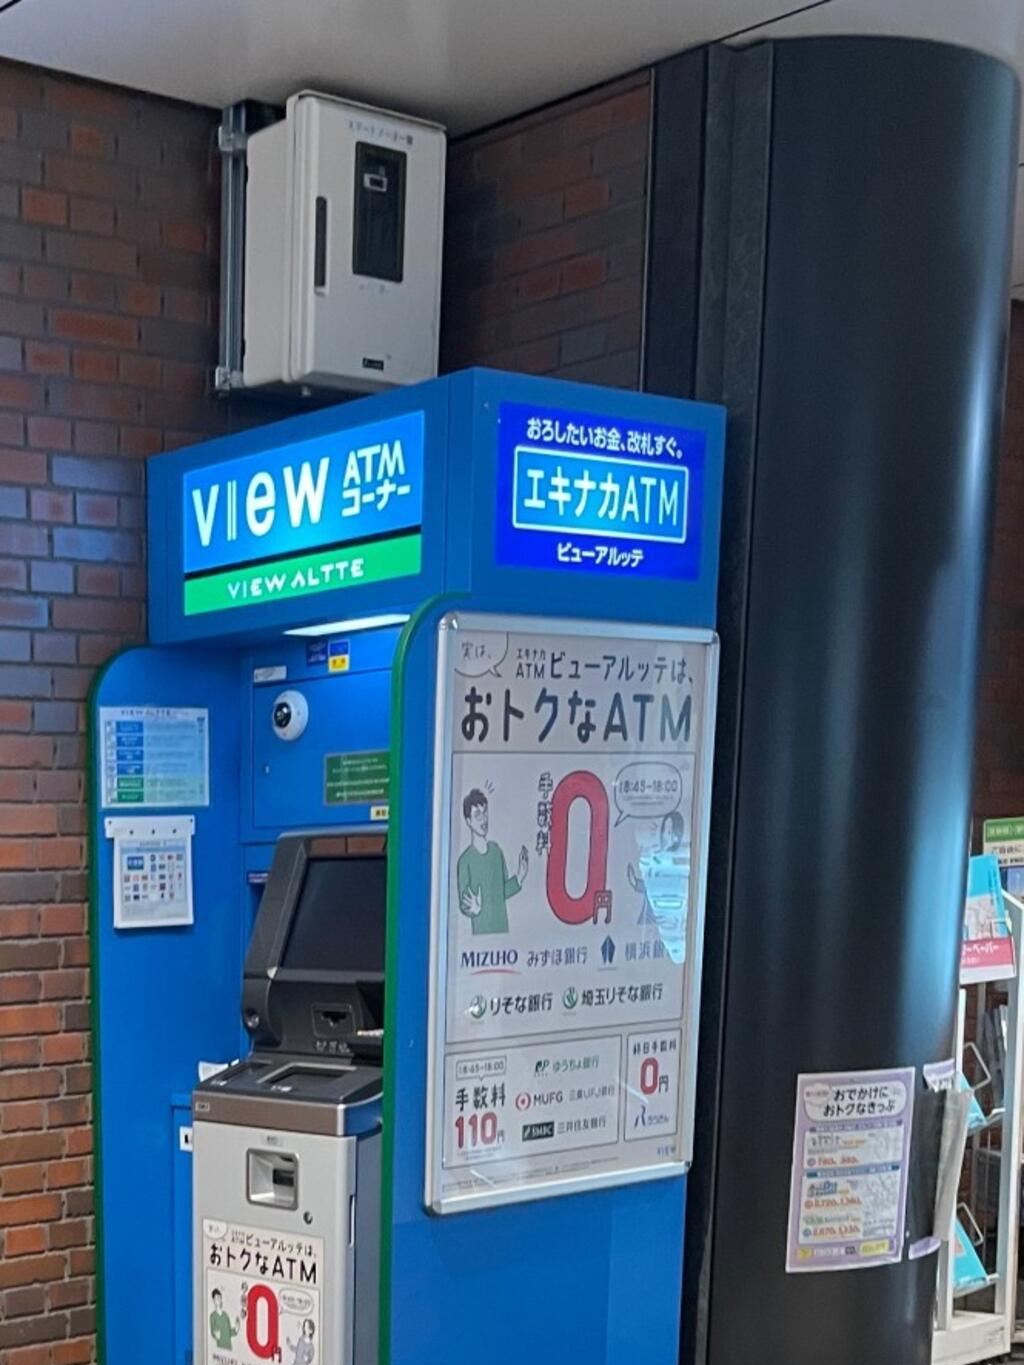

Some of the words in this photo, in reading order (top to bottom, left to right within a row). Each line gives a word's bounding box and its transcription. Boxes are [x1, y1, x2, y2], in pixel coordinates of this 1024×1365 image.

[527, 417, 683, 460] おろしたいお金、改札すぐ。
[343, 440, 406, 488] ATM
[341, 479, 410, 517] コーナー
[524, 466, 679, 526] エキナカATM
[557, 542, 644, 567] ビューアルッテ
[228, 573, 288, 600] VIEW
[291, 557, 365, 590] ALTTE
[516, 662, 545, 680] ATM
[461, 686, 693, 743] おトクなATM
[461, 949, 518, 968] MIZUHO
[527, 946, 588, 967] みずほ銀行
[490, 992, 553, 1014] りそな銀行
[581, 983, 664, 1006] 埼玉りそな銀行
[456, 1082, 506, 1112] 手数料
[533, 1090, 563, 1107] MUFG
[834, 1086, 889, 1102] おでかけに
[210, 1243, 316, 1284] おトクなATM
